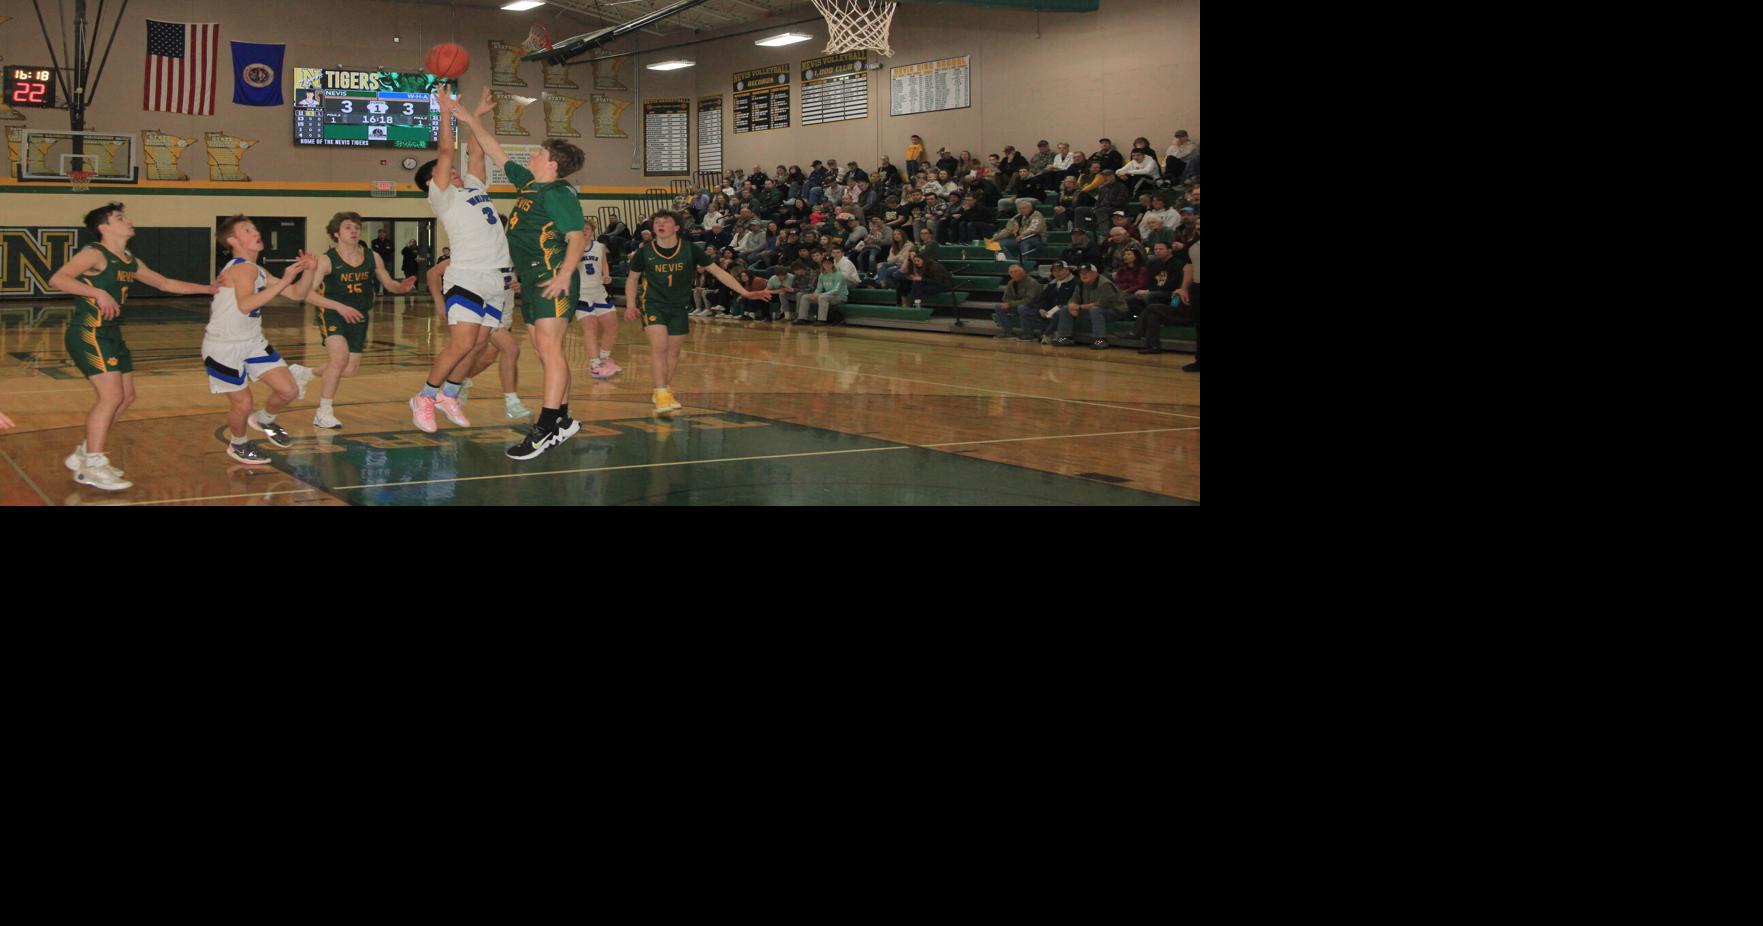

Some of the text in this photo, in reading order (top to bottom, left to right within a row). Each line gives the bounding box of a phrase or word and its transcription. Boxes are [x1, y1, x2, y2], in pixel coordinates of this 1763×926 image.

[14, 70, 50, 81] 16:18
[325, 70, 380, 91] TIGERS
[13, 82, 46, 103] 22
[341, 100, 353, 114] 3
[373, 104, 381, 113] 1
[402, 102, 415, 116] 3
[362, 115, 393, 124] 16:18
[482, 207, 498, 225] 3
[0, 228, 78, 295] N
[655, 263, 684, 273] NEVIS
[585, 263, 596, 276] 5
[341, 271, 369, 282] NEVIS
[667, 274, 673, 287] 1
